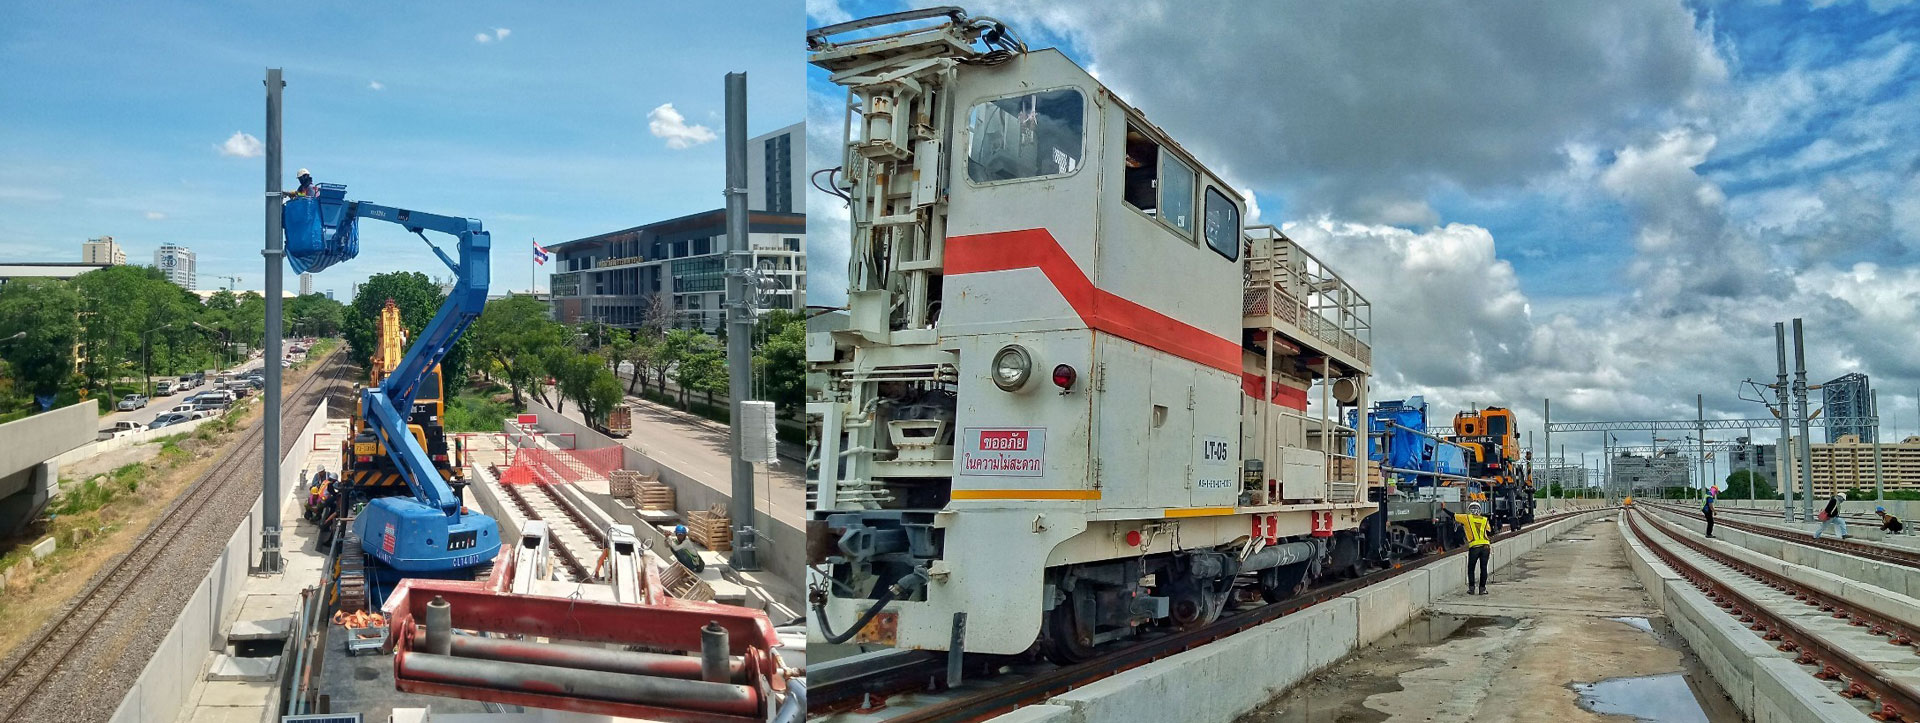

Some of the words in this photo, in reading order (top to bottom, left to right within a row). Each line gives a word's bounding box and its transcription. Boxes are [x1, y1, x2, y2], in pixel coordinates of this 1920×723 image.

[983, 432, 1025, 449] ขออภัย
[1204, 441, 1228, 460] LT-05
[965, 452, 1040, 471] ในความไม่สะดวก
